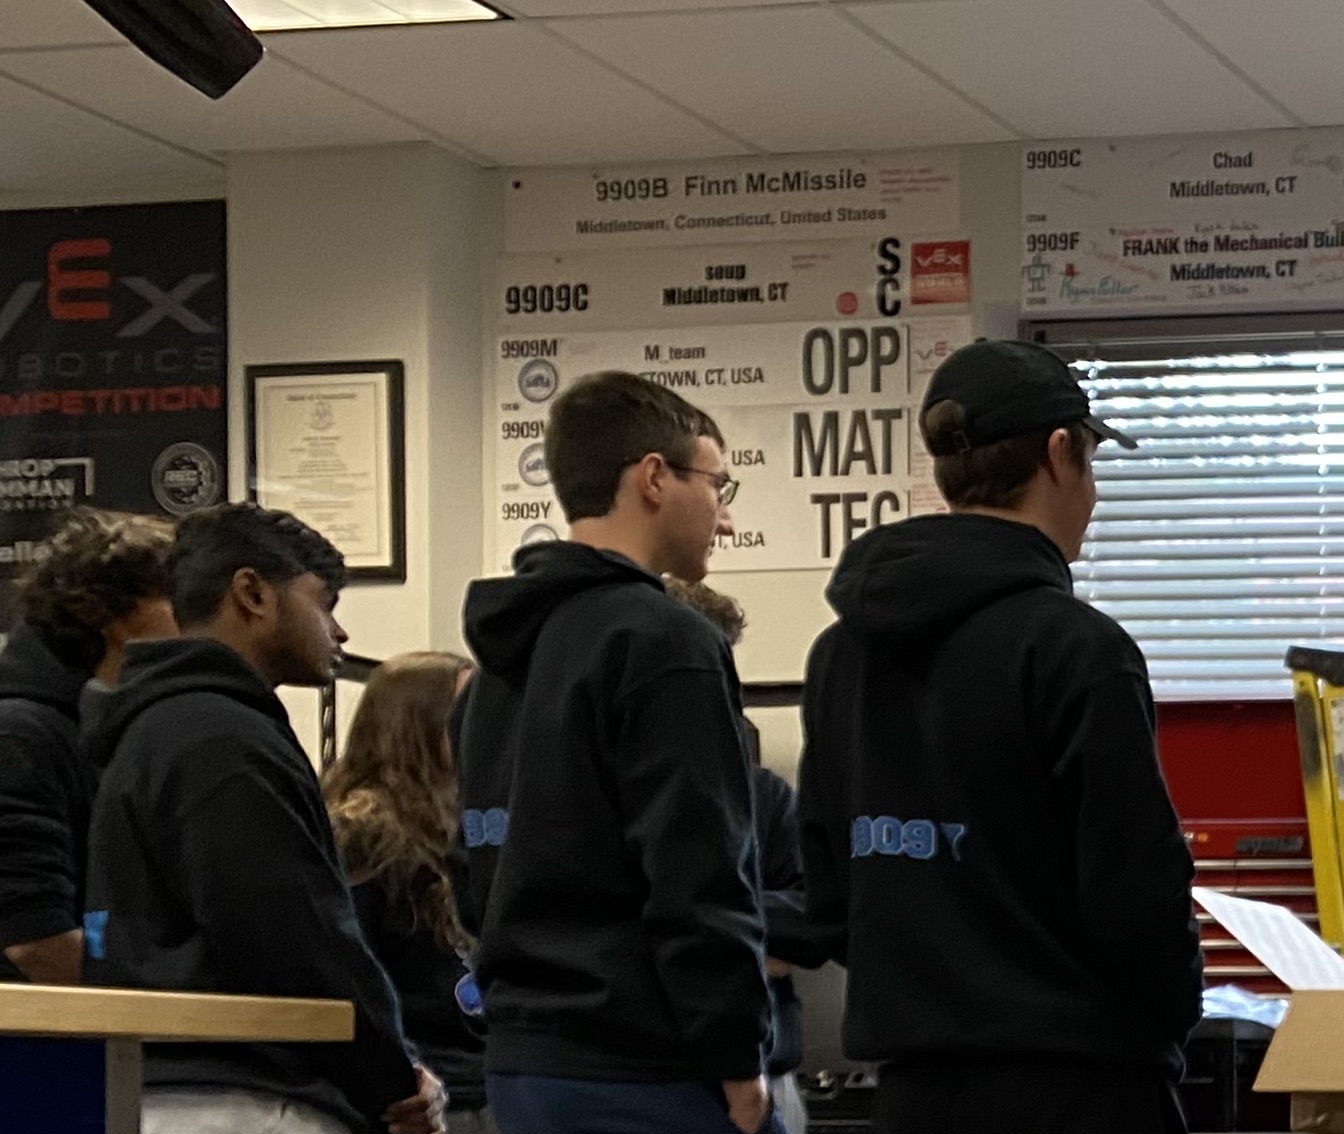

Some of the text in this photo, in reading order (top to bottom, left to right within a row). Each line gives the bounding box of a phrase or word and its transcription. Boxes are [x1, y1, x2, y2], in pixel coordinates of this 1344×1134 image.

[1026, 149, 1081, 169] 9909C
[1213, 151, 1253, 169] Chad
[595, 177, 669, 201] 9909B
[685, 173, 738, 197] Finn
[746, 168, 867, 194] McMissile
[1170, 176, 1297, 198] Middletown, CT
[576, 207, 887, 235] Middletown, Connecticut, United States
[1026, 232, 1080, 252] 9909F
[1123, 230, 1344, 256] FRANK the Mechanical Bull
[877, 237, 901, 276] S
[705, 264, 747, 280] soup
[1170, 260, 1297, 281] Middletown, CT
[505, 284, 589, 314] 9909C
[662, 283, 790, 306] Middletown, CT
[877, 277, 902, 317] C
[501, 339, 558, 358] 9909M
[802, 326, 900, 395] OPP
[731, 367, 765, 384] USA
[502, 421, 548, 440] 9909
[793, 407, 903, 478] MAT
[731, 449, 766, 466] USA
[502, 501, 551, 519] 9909Y
[732, 532, 766, 548] USA
[850, 815, 968, 862] 909Y
